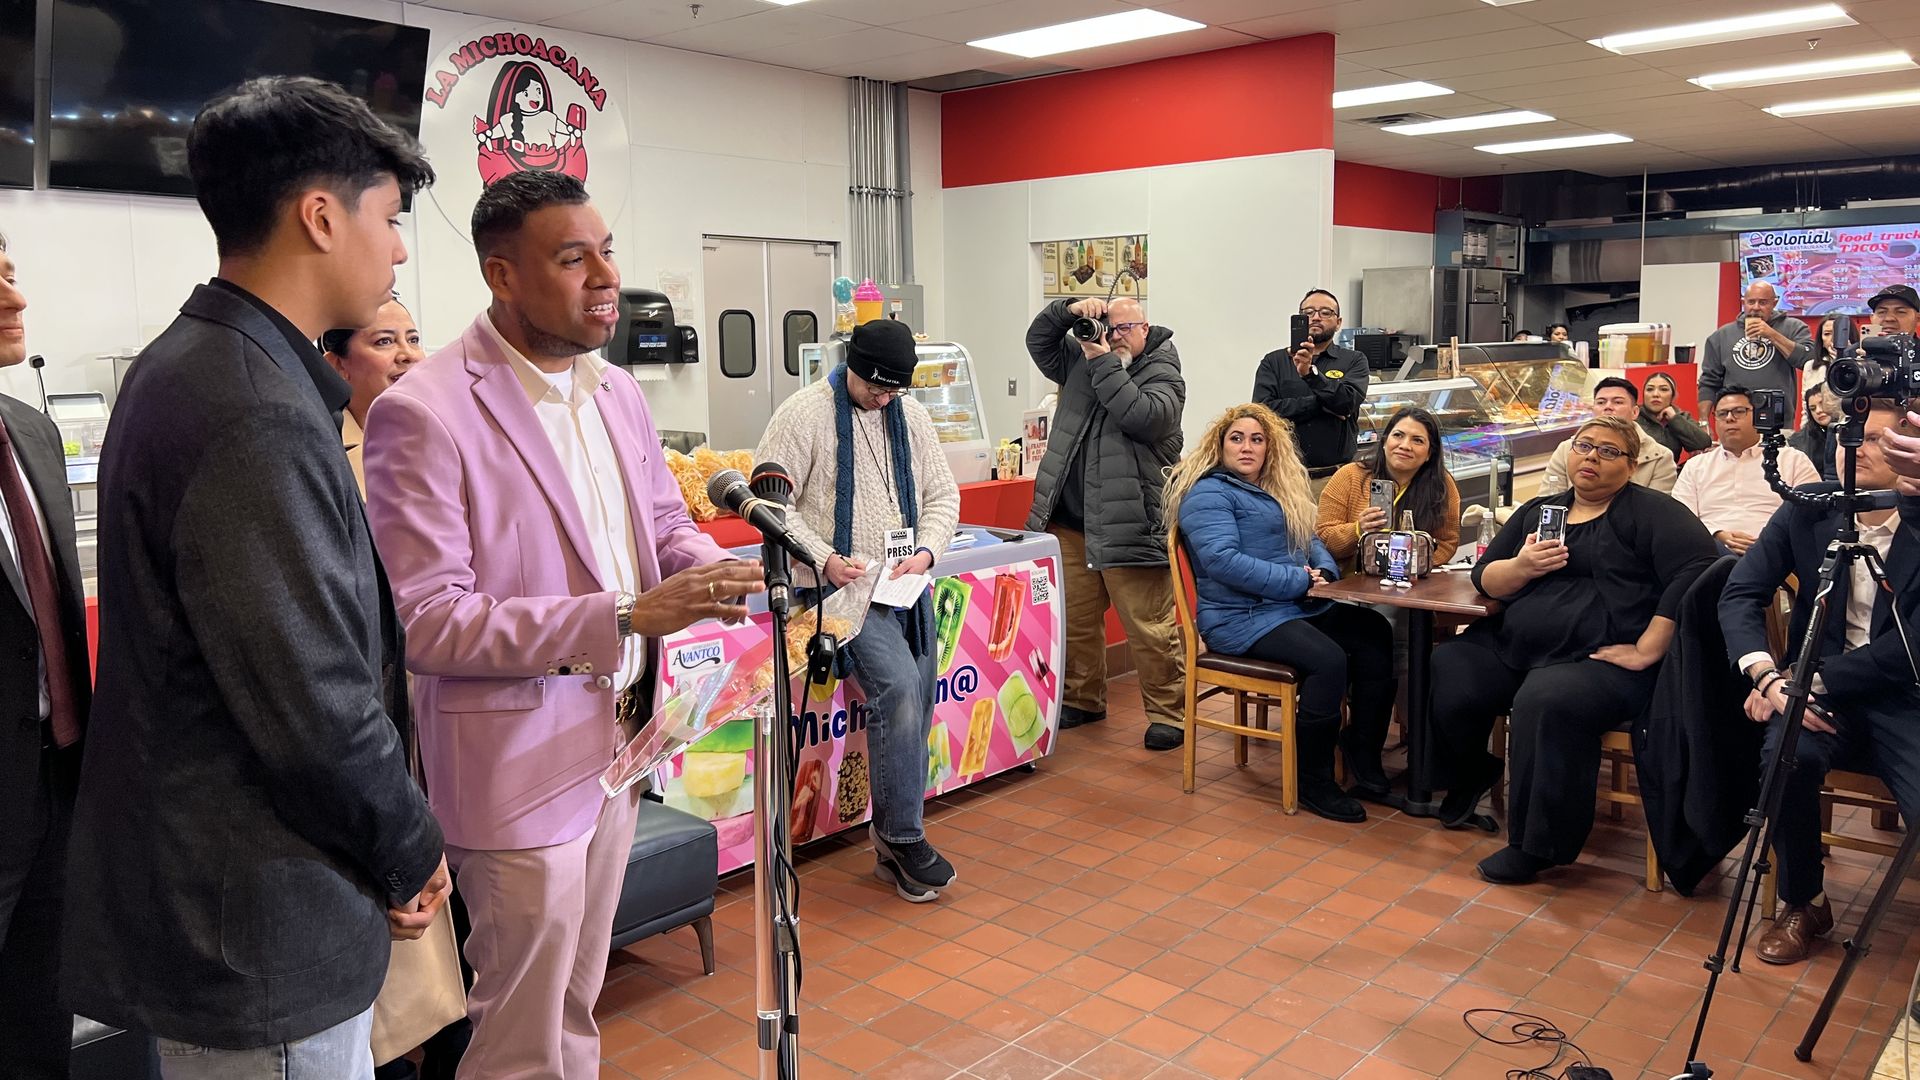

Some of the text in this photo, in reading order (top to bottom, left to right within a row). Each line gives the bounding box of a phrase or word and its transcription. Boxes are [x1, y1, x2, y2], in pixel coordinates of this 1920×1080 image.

[426, 33, 607, 112] LA MICHOACANA
[1764, 230, 1833, 247] Colonial
[1838, 231, 1873, 243] food
[1790, 243, 1828, 251] RESTAURANT
[1839, 243, 1890, 254] TACOS
[887, 544, 913, 559] PRESS
[672, 645, 721, 669] AVANTCO
